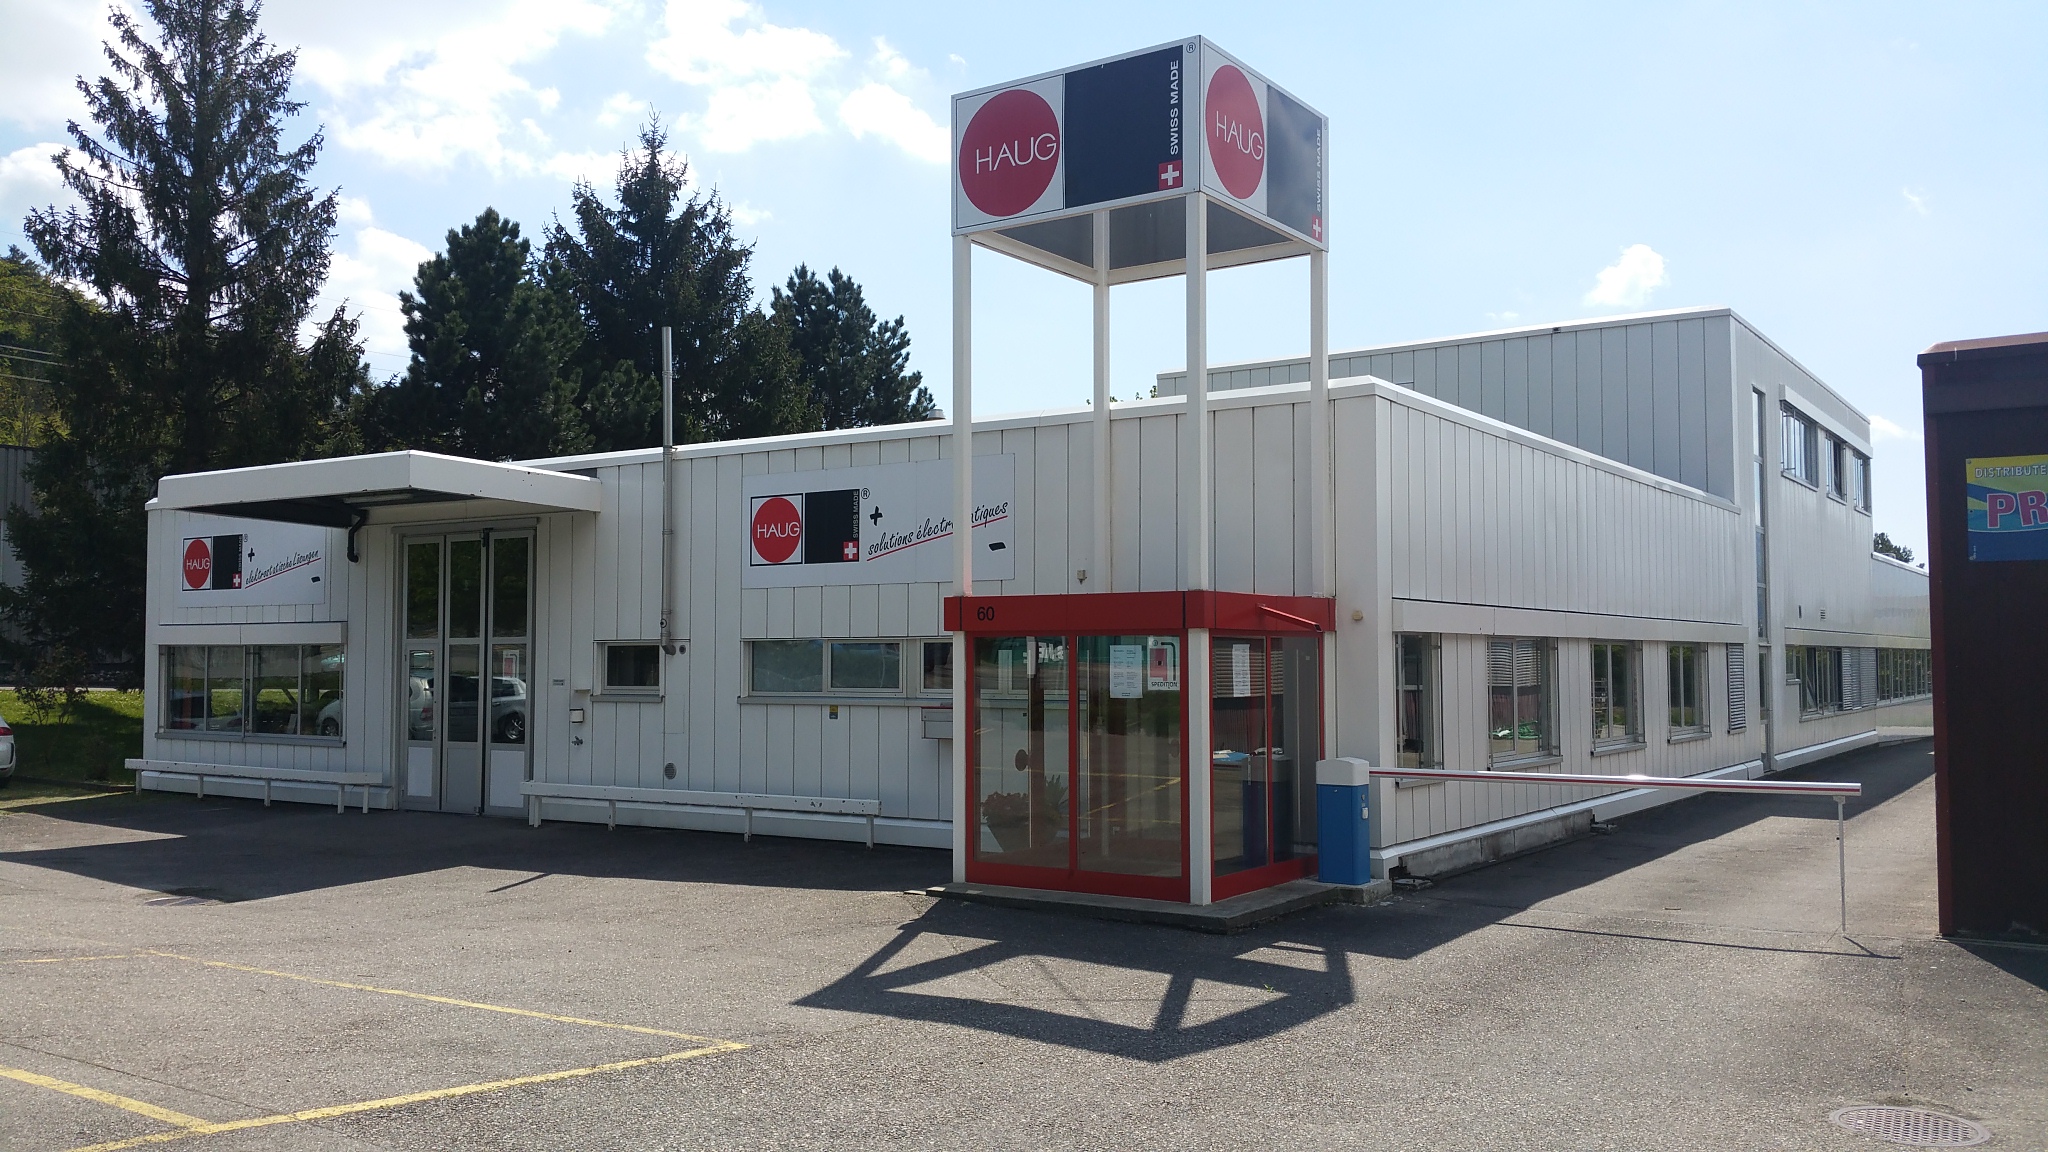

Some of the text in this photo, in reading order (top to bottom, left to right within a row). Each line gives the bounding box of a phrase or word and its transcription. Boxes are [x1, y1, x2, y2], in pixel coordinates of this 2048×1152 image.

[1170, 60, 1179, 155] SWISS MADE
[1216, 110, 1264, 160] HAUG
[975, 133, 1057, 174] HAUG
[1975, 465, 2047, 478] DISTRIBUTE
[757, 521, 800, 539] HAUG
[868, 502, 1009, 556] solutions électrtiques
[186, 557, 211, 571] HAUG
[976, 606, 995, 622] 60
[1151, 681, 1178, 689] SPEDITION
